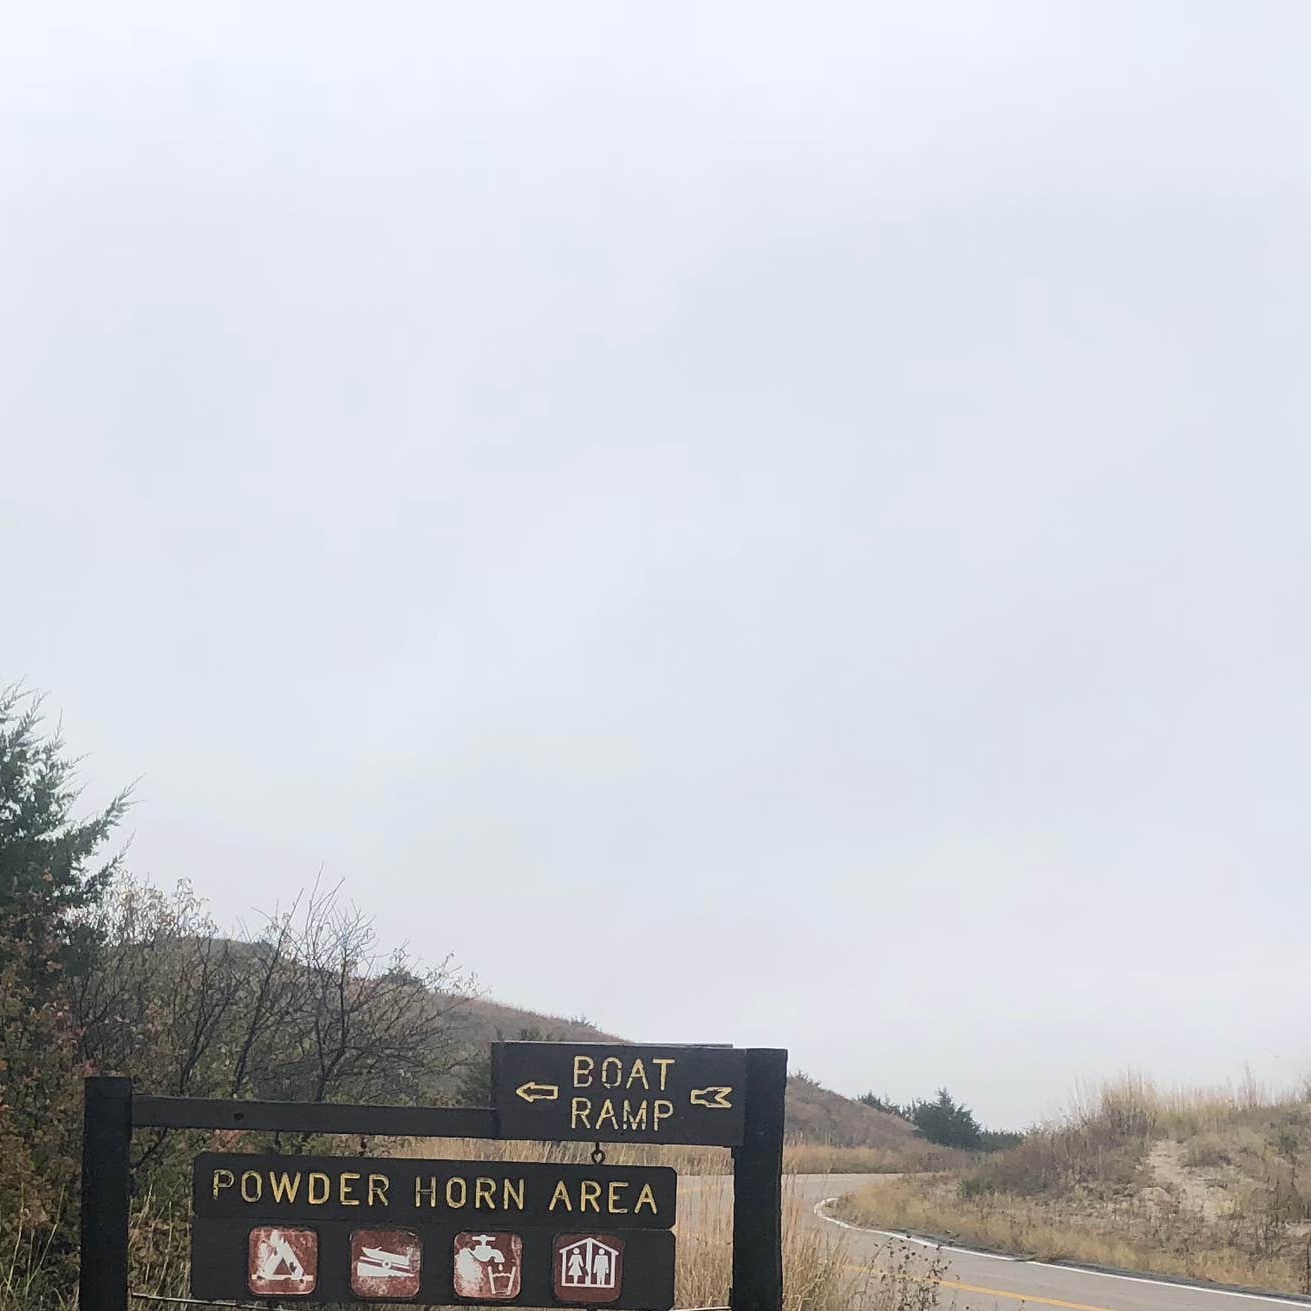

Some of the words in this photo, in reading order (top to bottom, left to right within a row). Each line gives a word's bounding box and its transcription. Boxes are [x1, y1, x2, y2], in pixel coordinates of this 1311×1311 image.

[573, 1055, 675, 1091] BOAT
[571, 1097, 674, 1131] RAMP
[212, 1169, 390, 1207] POWDER
[415, 1177, 525, 1211] HORN
[549, 1181, 658, 1215] AREA
